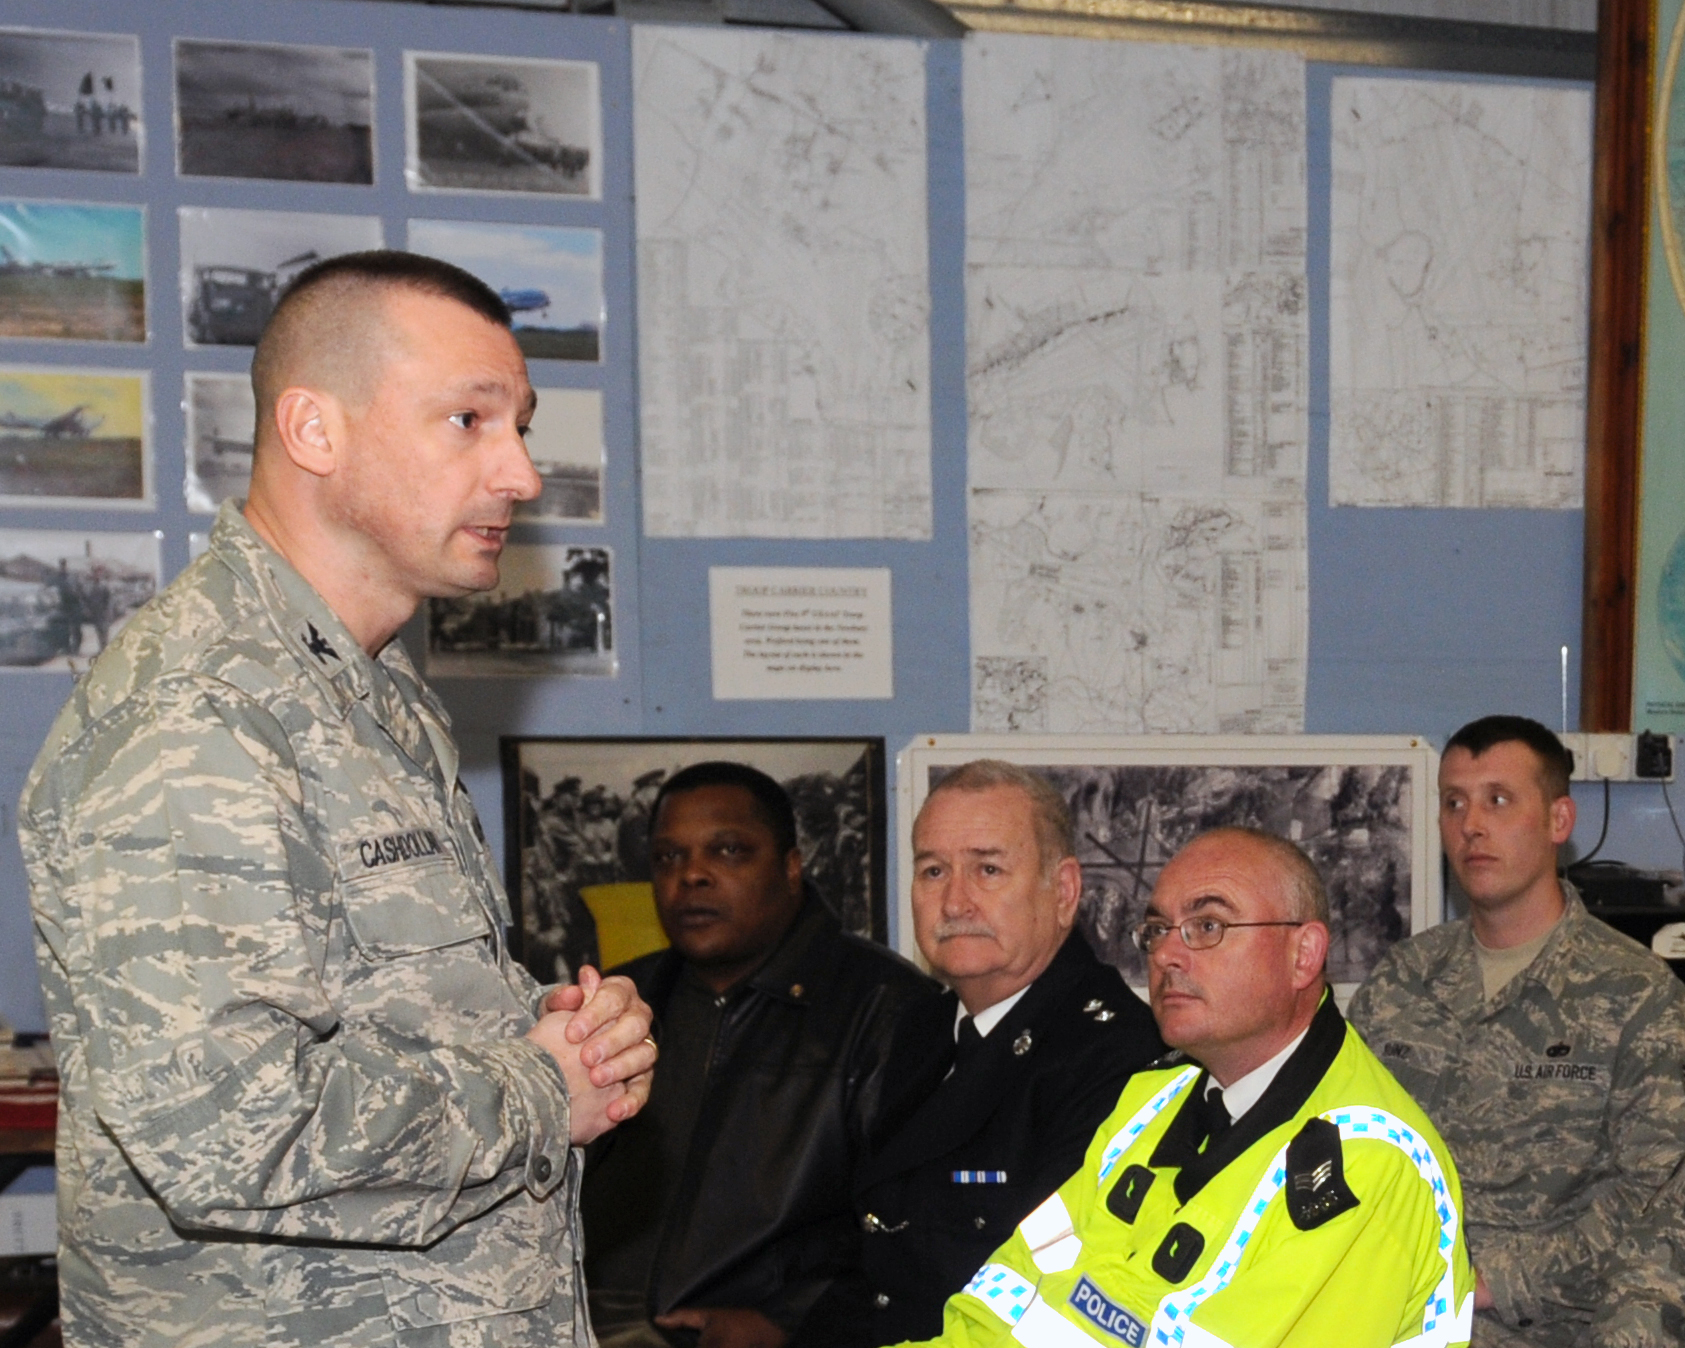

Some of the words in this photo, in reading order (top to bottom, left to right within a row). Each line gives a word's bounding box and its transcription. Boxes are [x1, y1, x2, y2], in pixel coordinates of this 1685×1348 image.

[1535, 1065, 1555, 1080] AIR
[1555, 1064, 1597, 1081] FORCE
[1075, 1283, 1140, 1345] POLICE
